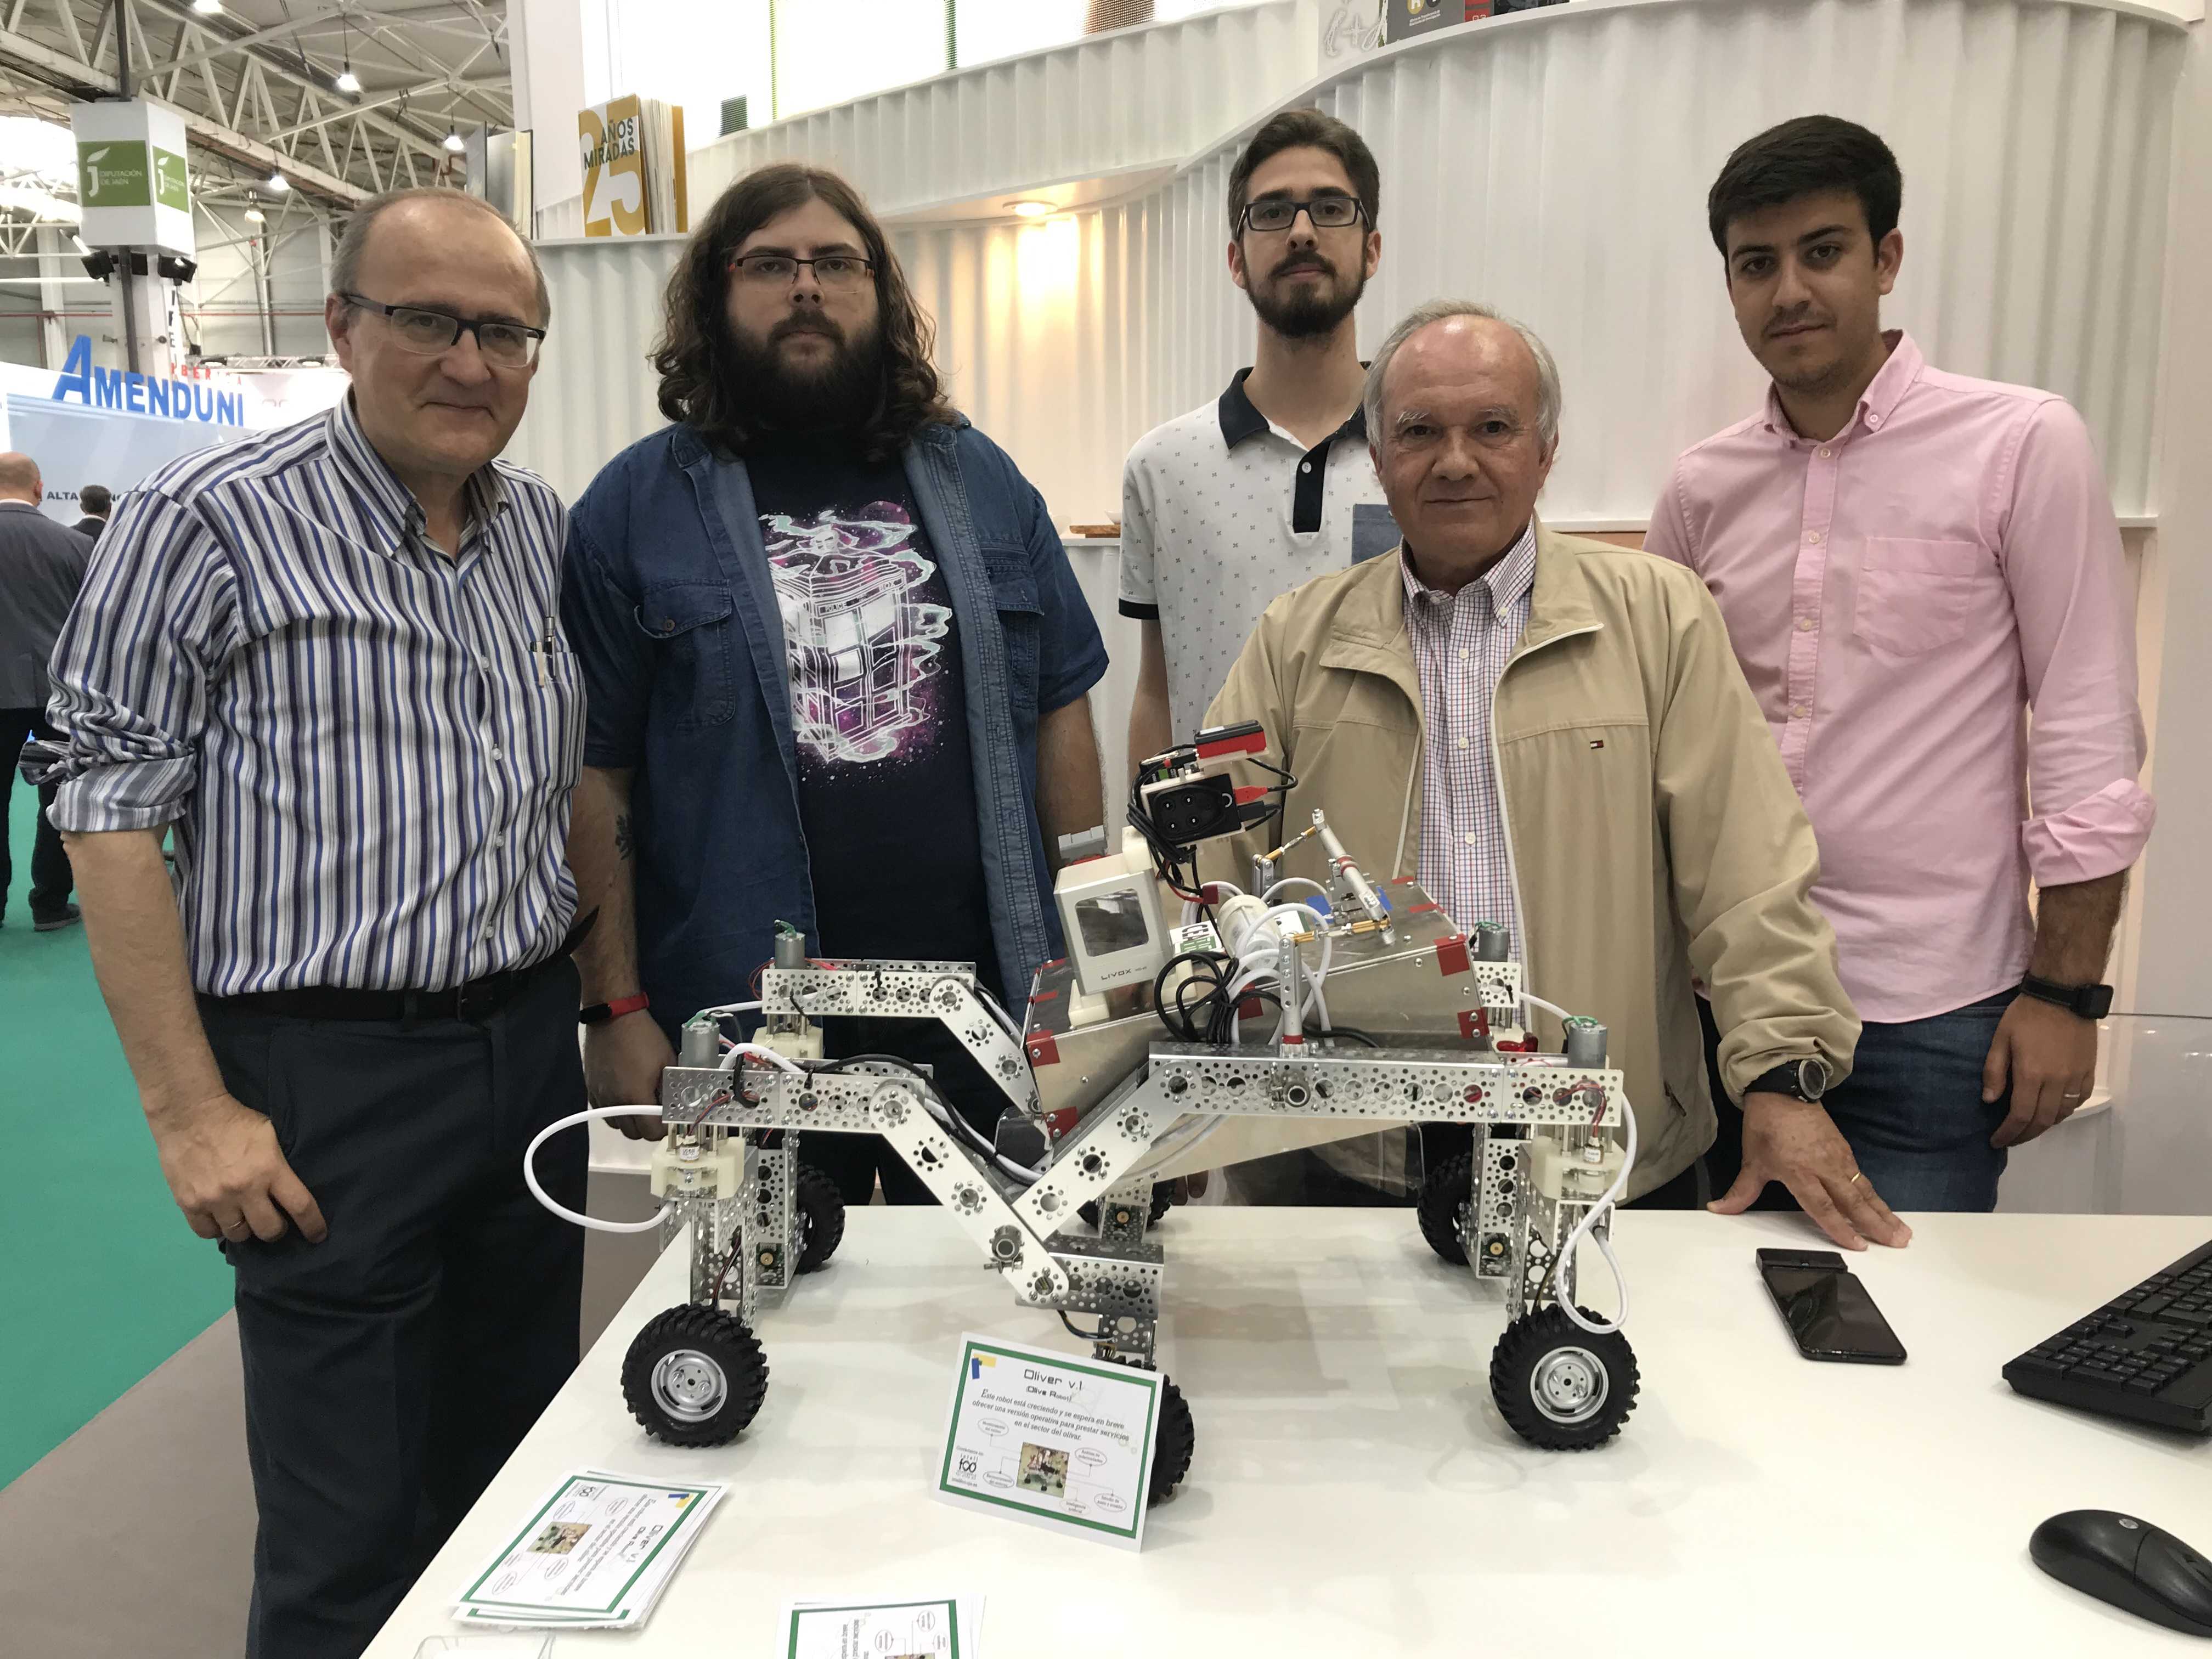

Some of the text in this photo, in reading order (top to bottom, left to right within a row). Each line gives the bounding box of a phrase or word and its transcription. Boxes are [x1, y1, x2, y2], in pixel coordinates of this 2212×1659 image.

[600, 117, 634, 145] AÑOS
[584, 137, 635, 170] MIRADAS
[52, 334, 244, 427] AMENDUNI
[47, 491, 78, 500] ALTA
[825, 581, 895, 612] POLICE BOX
[1101, 969, 1132, 980] LIVOX
[1024, 1369, 1063, 1385] Oliver
[972, 1399, 994, 1410] ofrecer
[1007, 1408, 1030, 1419] versión
[1030, 1413, 1059, 1425] operativa
[1059, 1420, 1075, 1429] para
[1075, 1424, 1099, 1434] prestar
[1100, 1429, 1130, 1442] servicios
[981, 1389, 996, 1400] Este
[996, 1395, 1013, 1404] robot
[1014, 1400, 1026, 1408] está
[1027, 1402, 1058, 1414] creciendo
[1073, 1413, 1095, 1423] espera
[1105, 1419, 1125, 1429] breve
[1030, 1424, 1051, 1434] sector
[1063, 1430, 1082, 1441] olivar.
